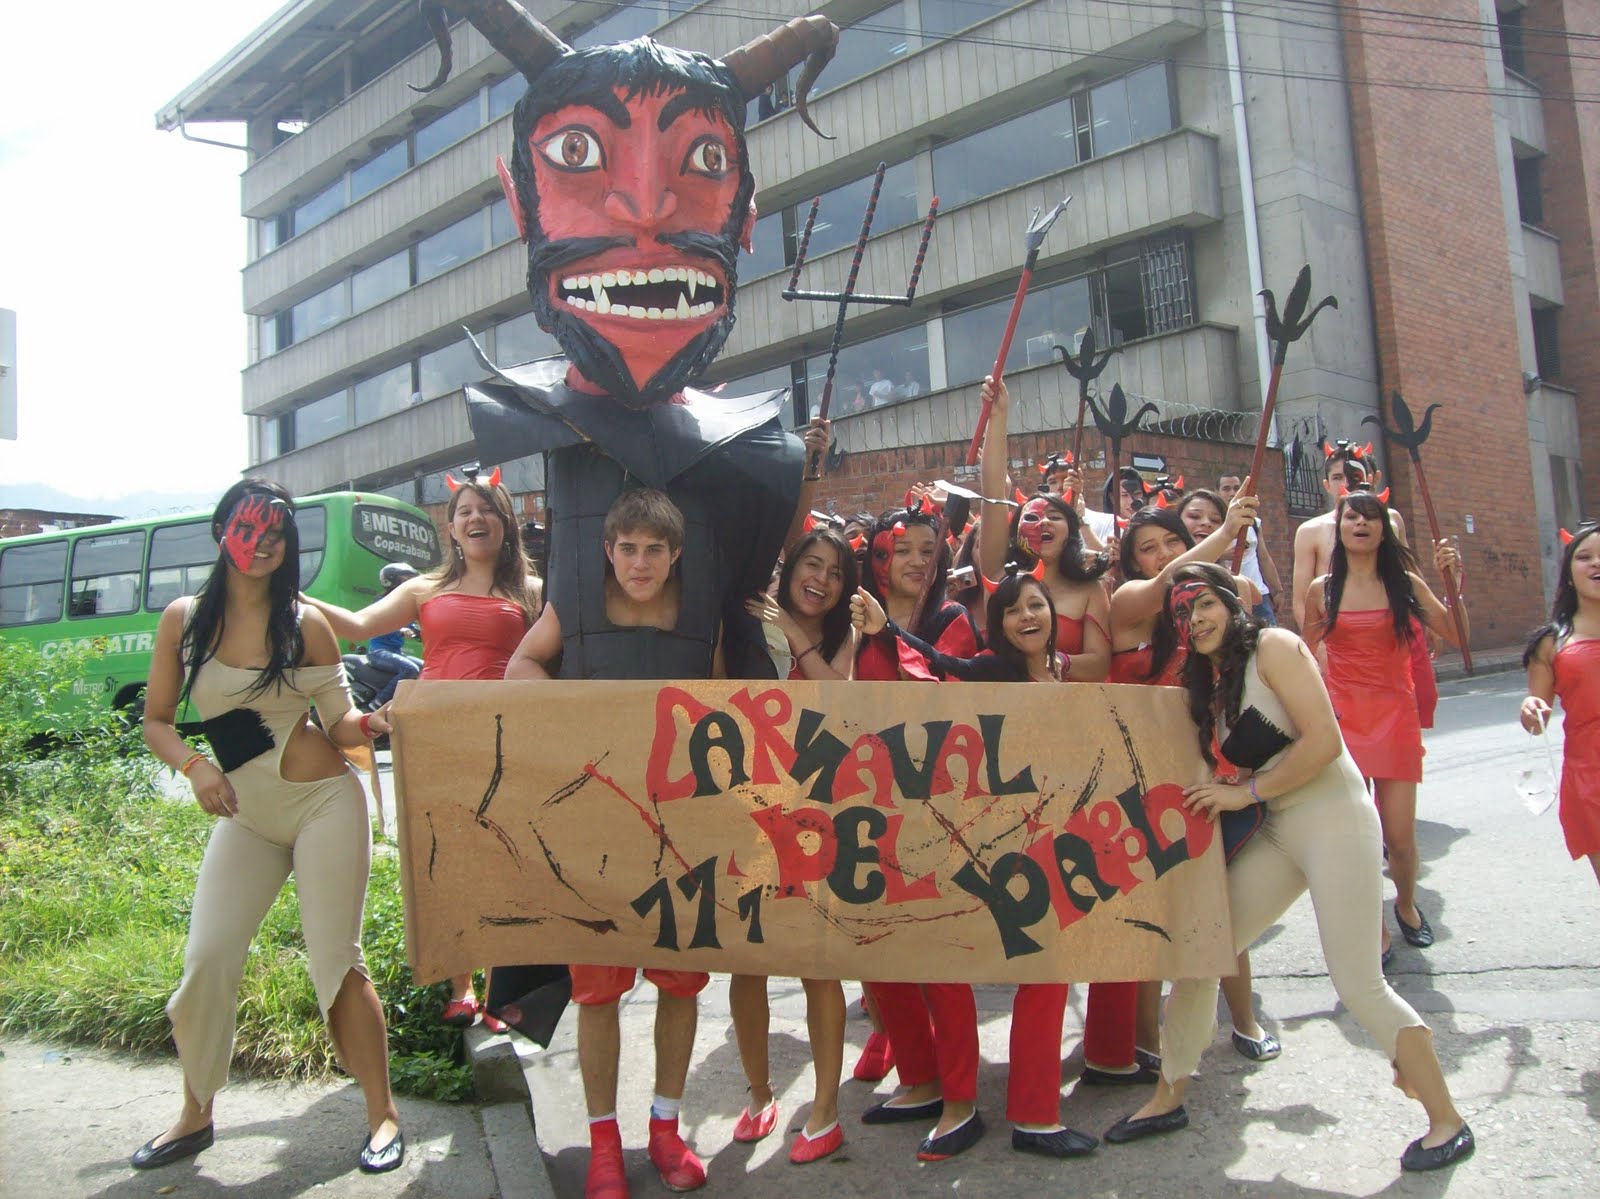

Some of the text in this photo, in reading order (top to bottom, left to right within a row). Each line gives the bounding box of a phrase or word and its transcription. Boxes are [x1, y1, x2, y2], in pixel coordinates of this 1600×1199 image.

[371, 512, 429, 544] METRO
[374, 534, 431, 561] Copacabana
[41, 632, 156, 660] COOATR
[646, 686, 1040, 809] CARNAVAL
[750, 803, 943, 906] DEL
[951, 782, 1214, 960] DIABLO
